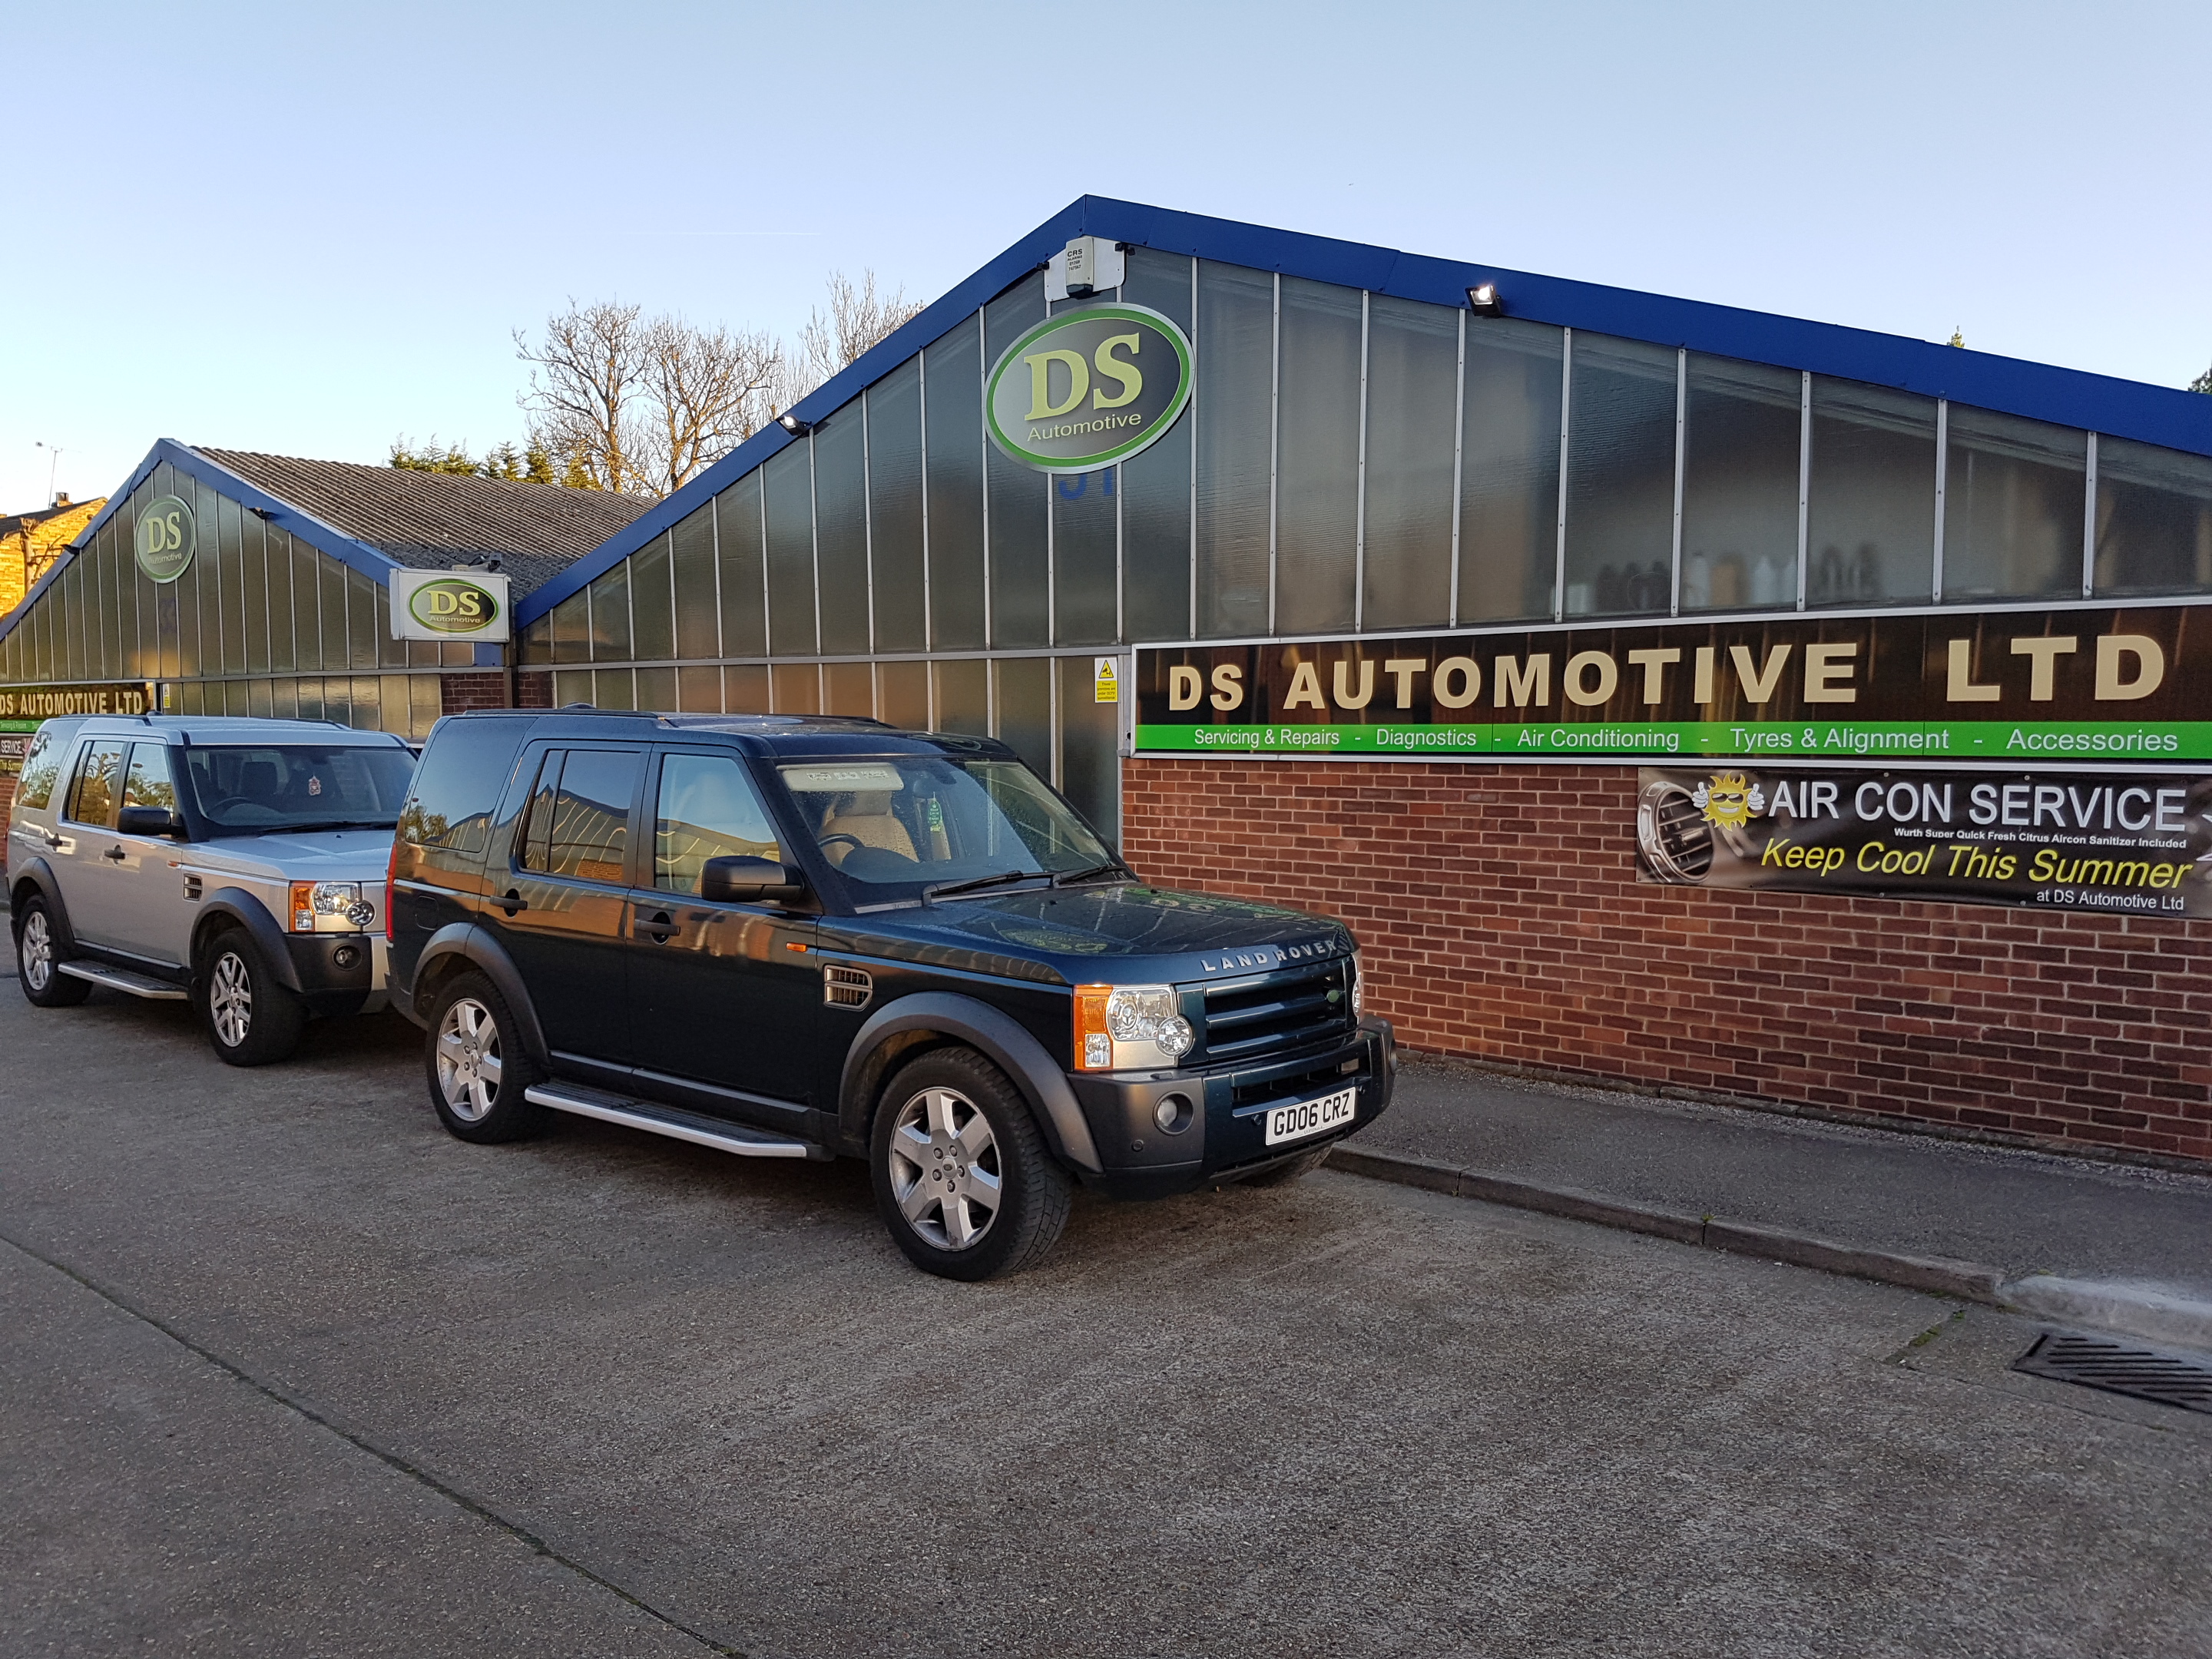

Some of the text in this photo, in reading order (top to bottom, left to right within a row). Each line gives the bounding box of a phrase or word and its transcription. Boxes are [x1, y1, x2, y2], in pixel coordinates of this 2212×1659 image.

[1068, 249, 1083, 257] CRS
[1024, 333, 1143, 421] DS
[1027, 413, 1142, 442] Automotive
[147, 511, 181, 555] DS
[149, 552, 182, 565] Automotive
[427, 591, 481, 616] DS
[1169, 634, 2164, 711] DS AUTOMOTIVE LTD
[0, 694, 14, 715] DS
[20, 692, 108, 715] AUTOMOTIVE
[115, 691, 143, 714] LTD
[1, 740, 23, 754] SERVICE
[1194, 729, 1260, 748] Servicing
[1265, 729, 1275, 745] &
[1280, 729, 1339, 748] Repairs
[1376, 729, 1477, 750] Diagnostics
[1517, 729, 1545, 747] Air
[1551, 729, 1679, 752] Conditioning
[1730, 728, 1793, 752] Tyres
[1800, 728, 1817, 748] &
[1823, 728, 1949, 753] Alignment
[2005, 728, 2178, 751] Accessories
[1768, 780, 2187, 831] AIR CON SERVICE
[1894, 827, 2187, 849] Wurth Super Quick Fresh Citrus Aircon Sanitizer Included
[1760, 837, 2194, 889] Keep Cool This Summer
[2036, 889, 2184, 911] at DS Automotive Ltd
[1200, 940, 1336, 972] LAND ROVER
[1273, 1092, 1350, 1136] GD06 CRZ
